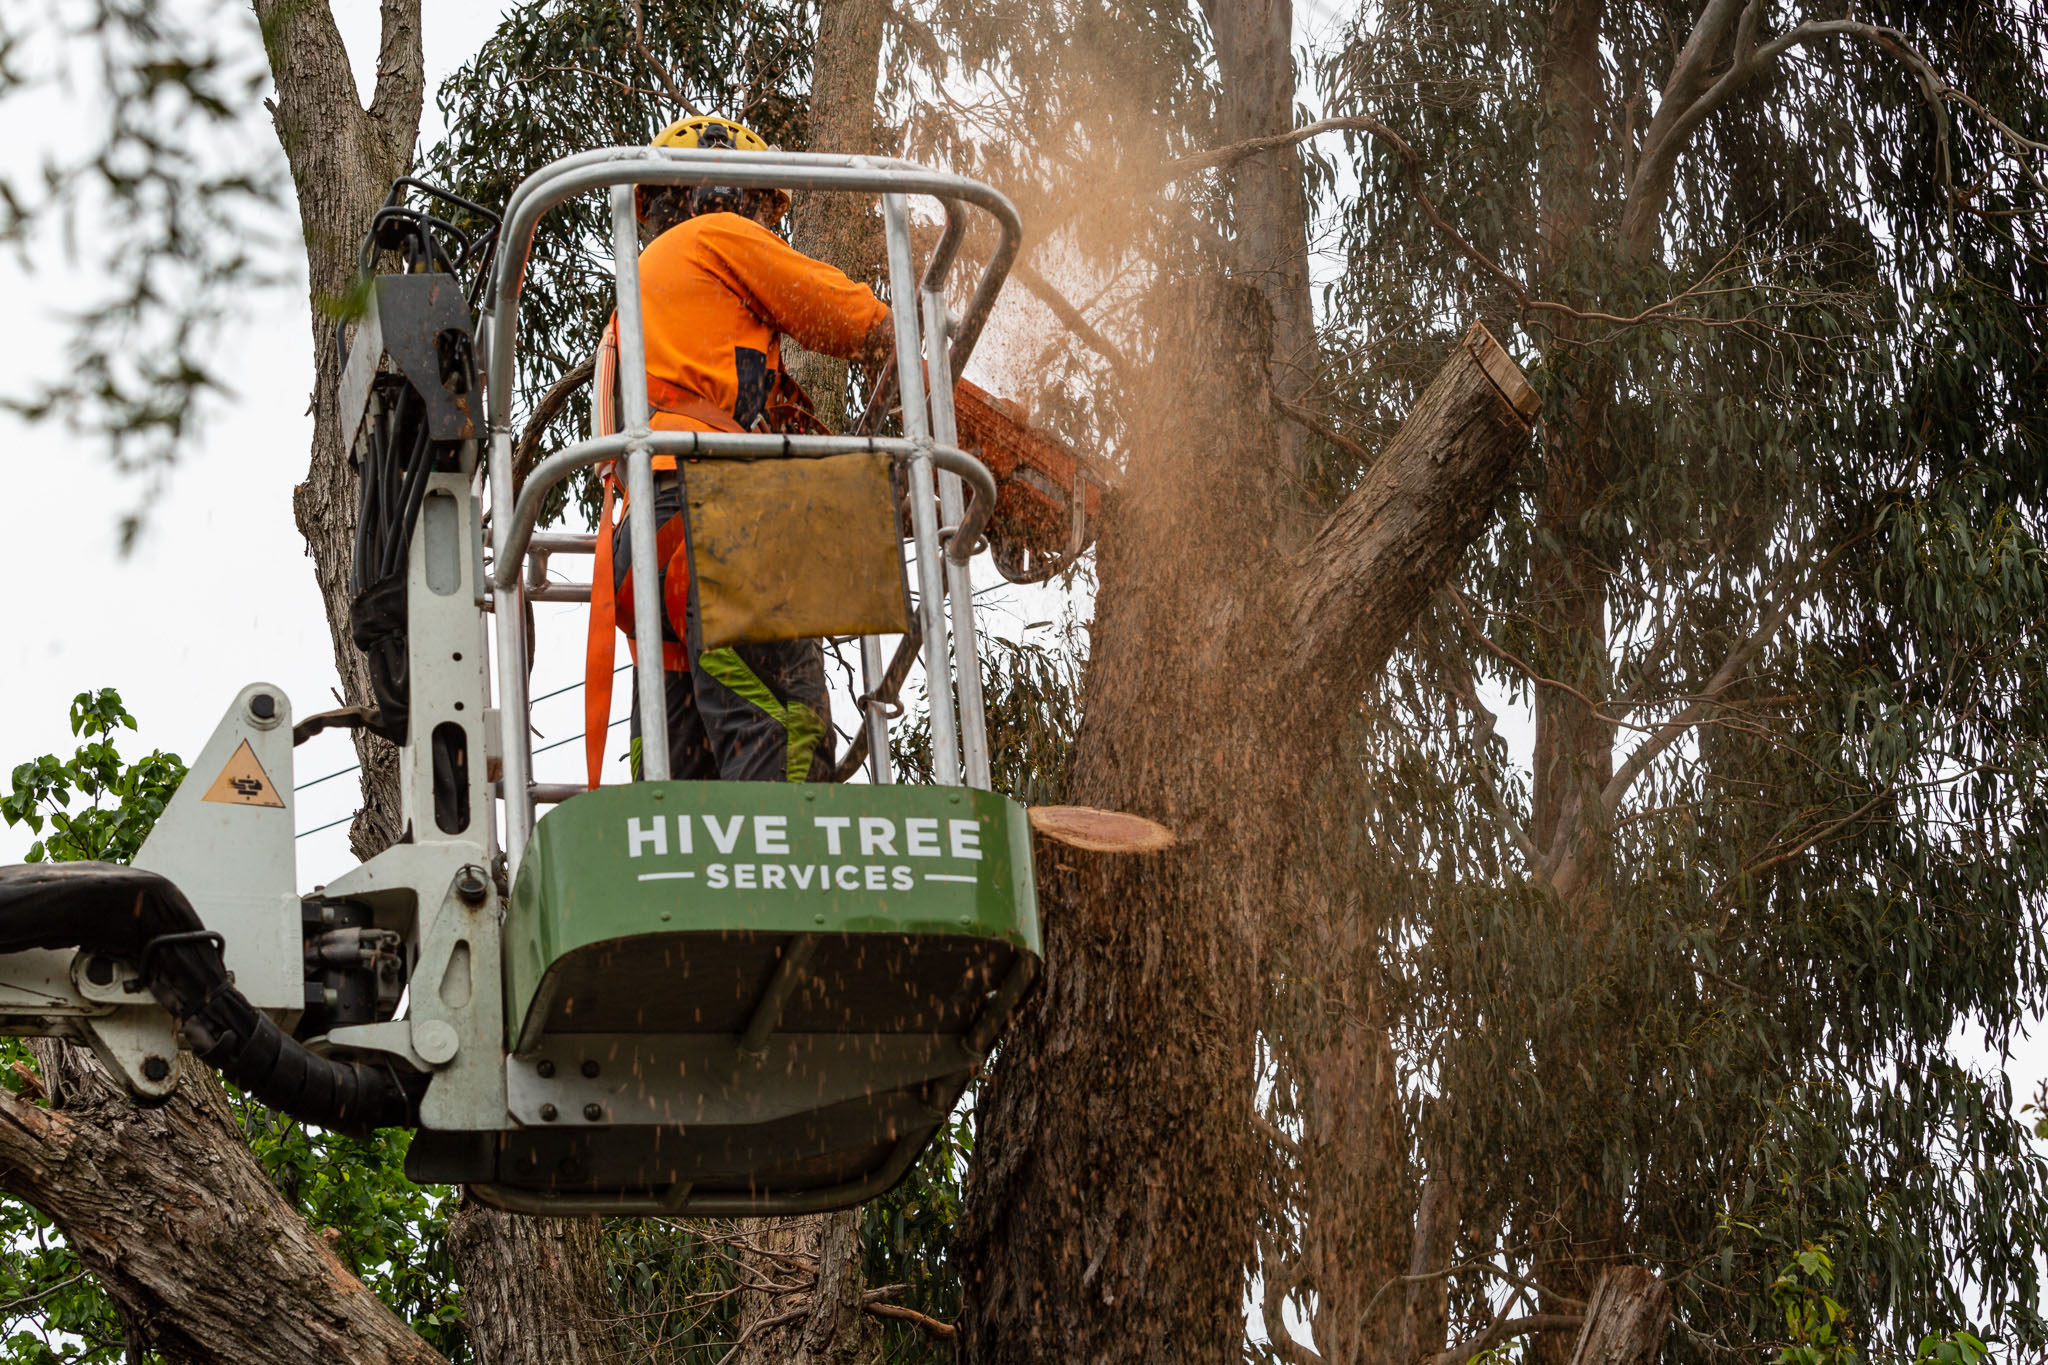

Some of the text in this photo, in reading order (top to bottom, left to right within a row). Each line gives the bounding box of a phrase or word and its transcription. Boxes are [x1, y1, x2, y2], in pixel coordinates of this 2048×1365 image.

[627, 814, 983, 860] HIVE TREE
[706, 863, 914, 891] SERVICES
